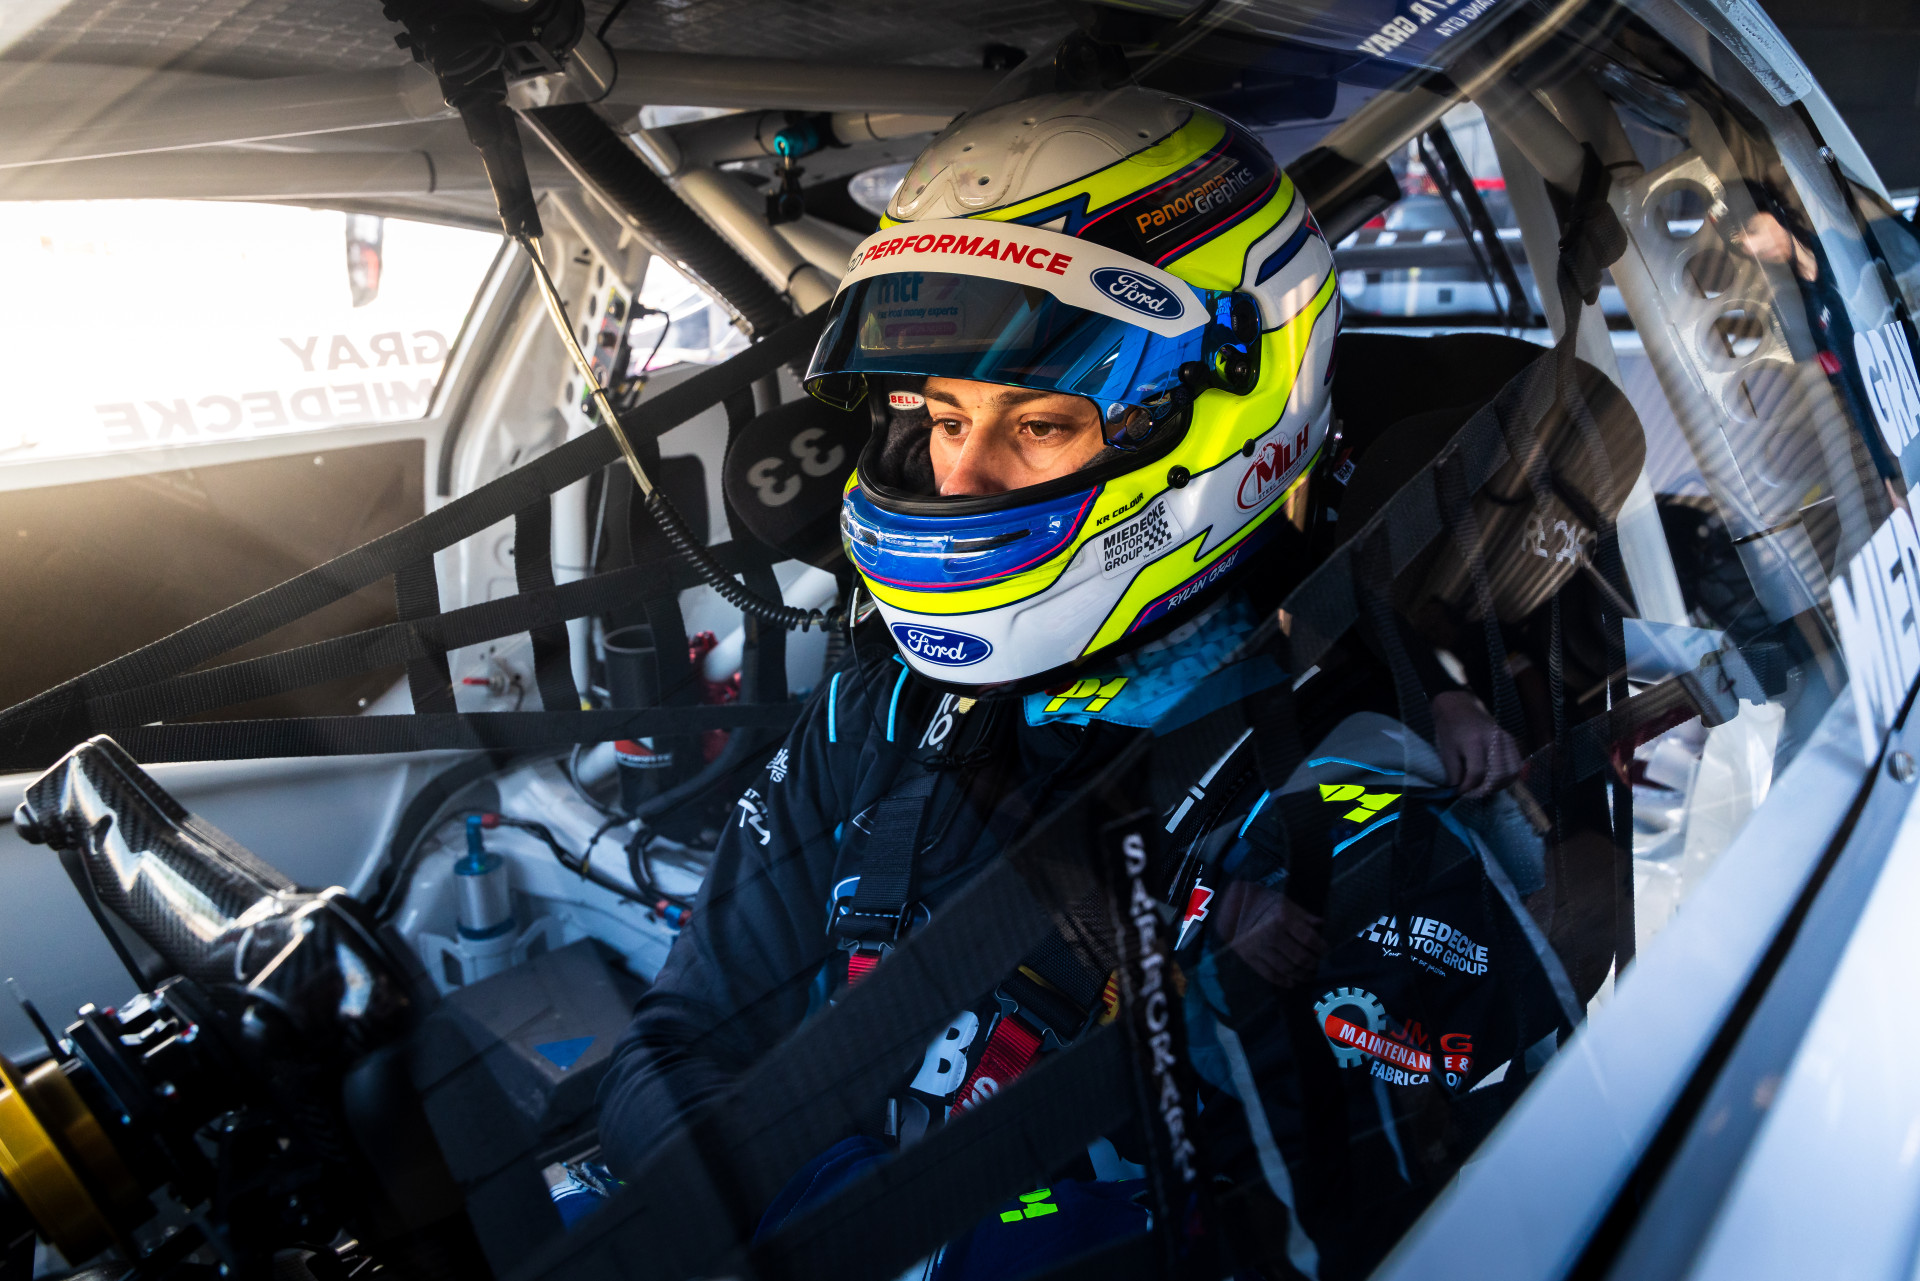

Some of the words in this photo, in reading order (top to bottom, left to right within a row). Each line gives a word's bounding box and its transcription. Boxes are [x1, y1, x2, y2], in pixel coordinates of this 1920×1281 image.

[1136, 174, 1227, 234] Panorama
[1195, 167, 1255, 215] Graphics
[860, 234, 1073, 276] PERFORMANCE
[928, 306, 959, 317] experts
[1109, 274, 1168, 312] Ford
[890, 395, 919, 404] BELL
[1256, 423, 1309, 495] MLH
[1096, 512, 1111, 527] KR
[1112, 492, 1144, 519] COLOUR
[1103, 501, 1166, 550] MIEDECKE
[1104, 535, 1144, 561] MOTOR
[1104, 545, 1144, 572] GROUP
[1167, 578, 1207, 610] RYLAN
[1209, 550, 1239, 583] GRAY
[907, 629, 967, 661] Ford
[1409, 915, 1488, 963] IEDECKE
[1442, 950, 1488, 976] GROUP
[1339, 1023, 1453, 1070] MAINTENANE
